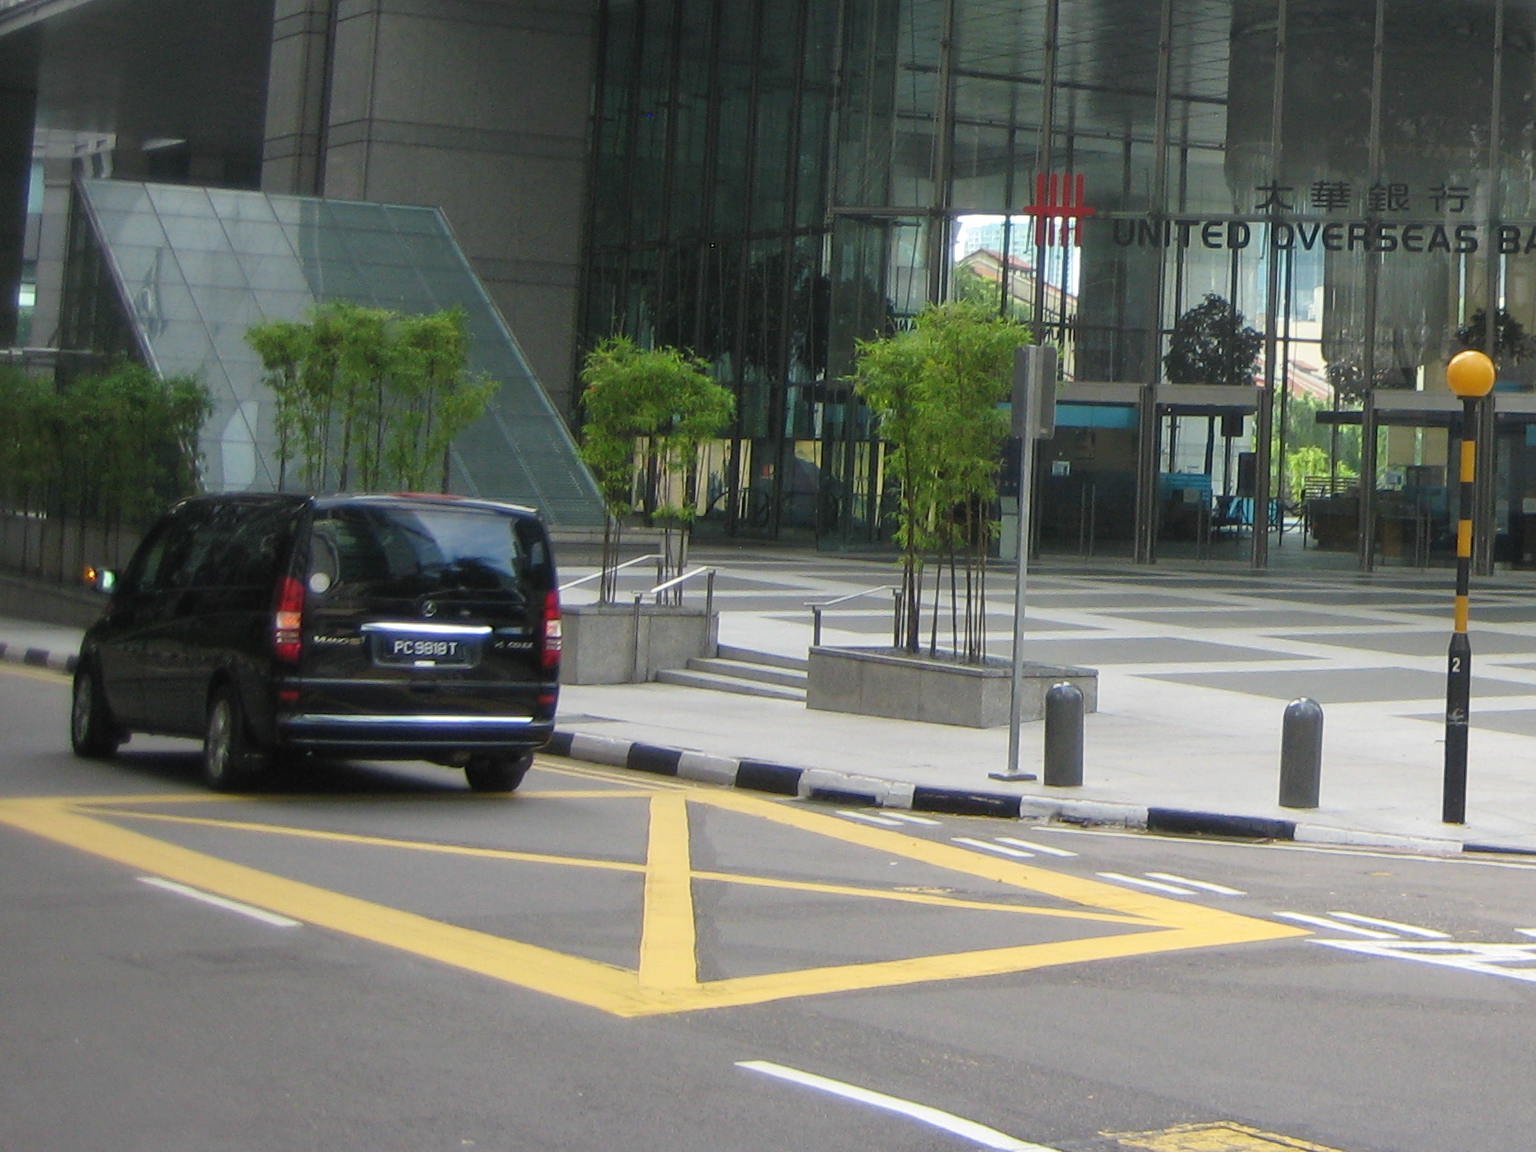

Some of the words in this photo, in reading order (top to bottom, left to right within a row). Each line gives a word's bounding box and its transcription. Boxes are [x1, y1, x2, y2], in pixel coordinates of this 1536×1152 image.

[1254, 180, 1470, 214] 大華銀行
[1112, 218, 1251, 249] UNITED
[1271, 220, 1479, 254] OVERSEAS
[1451, 656, 1461, 673] 2
